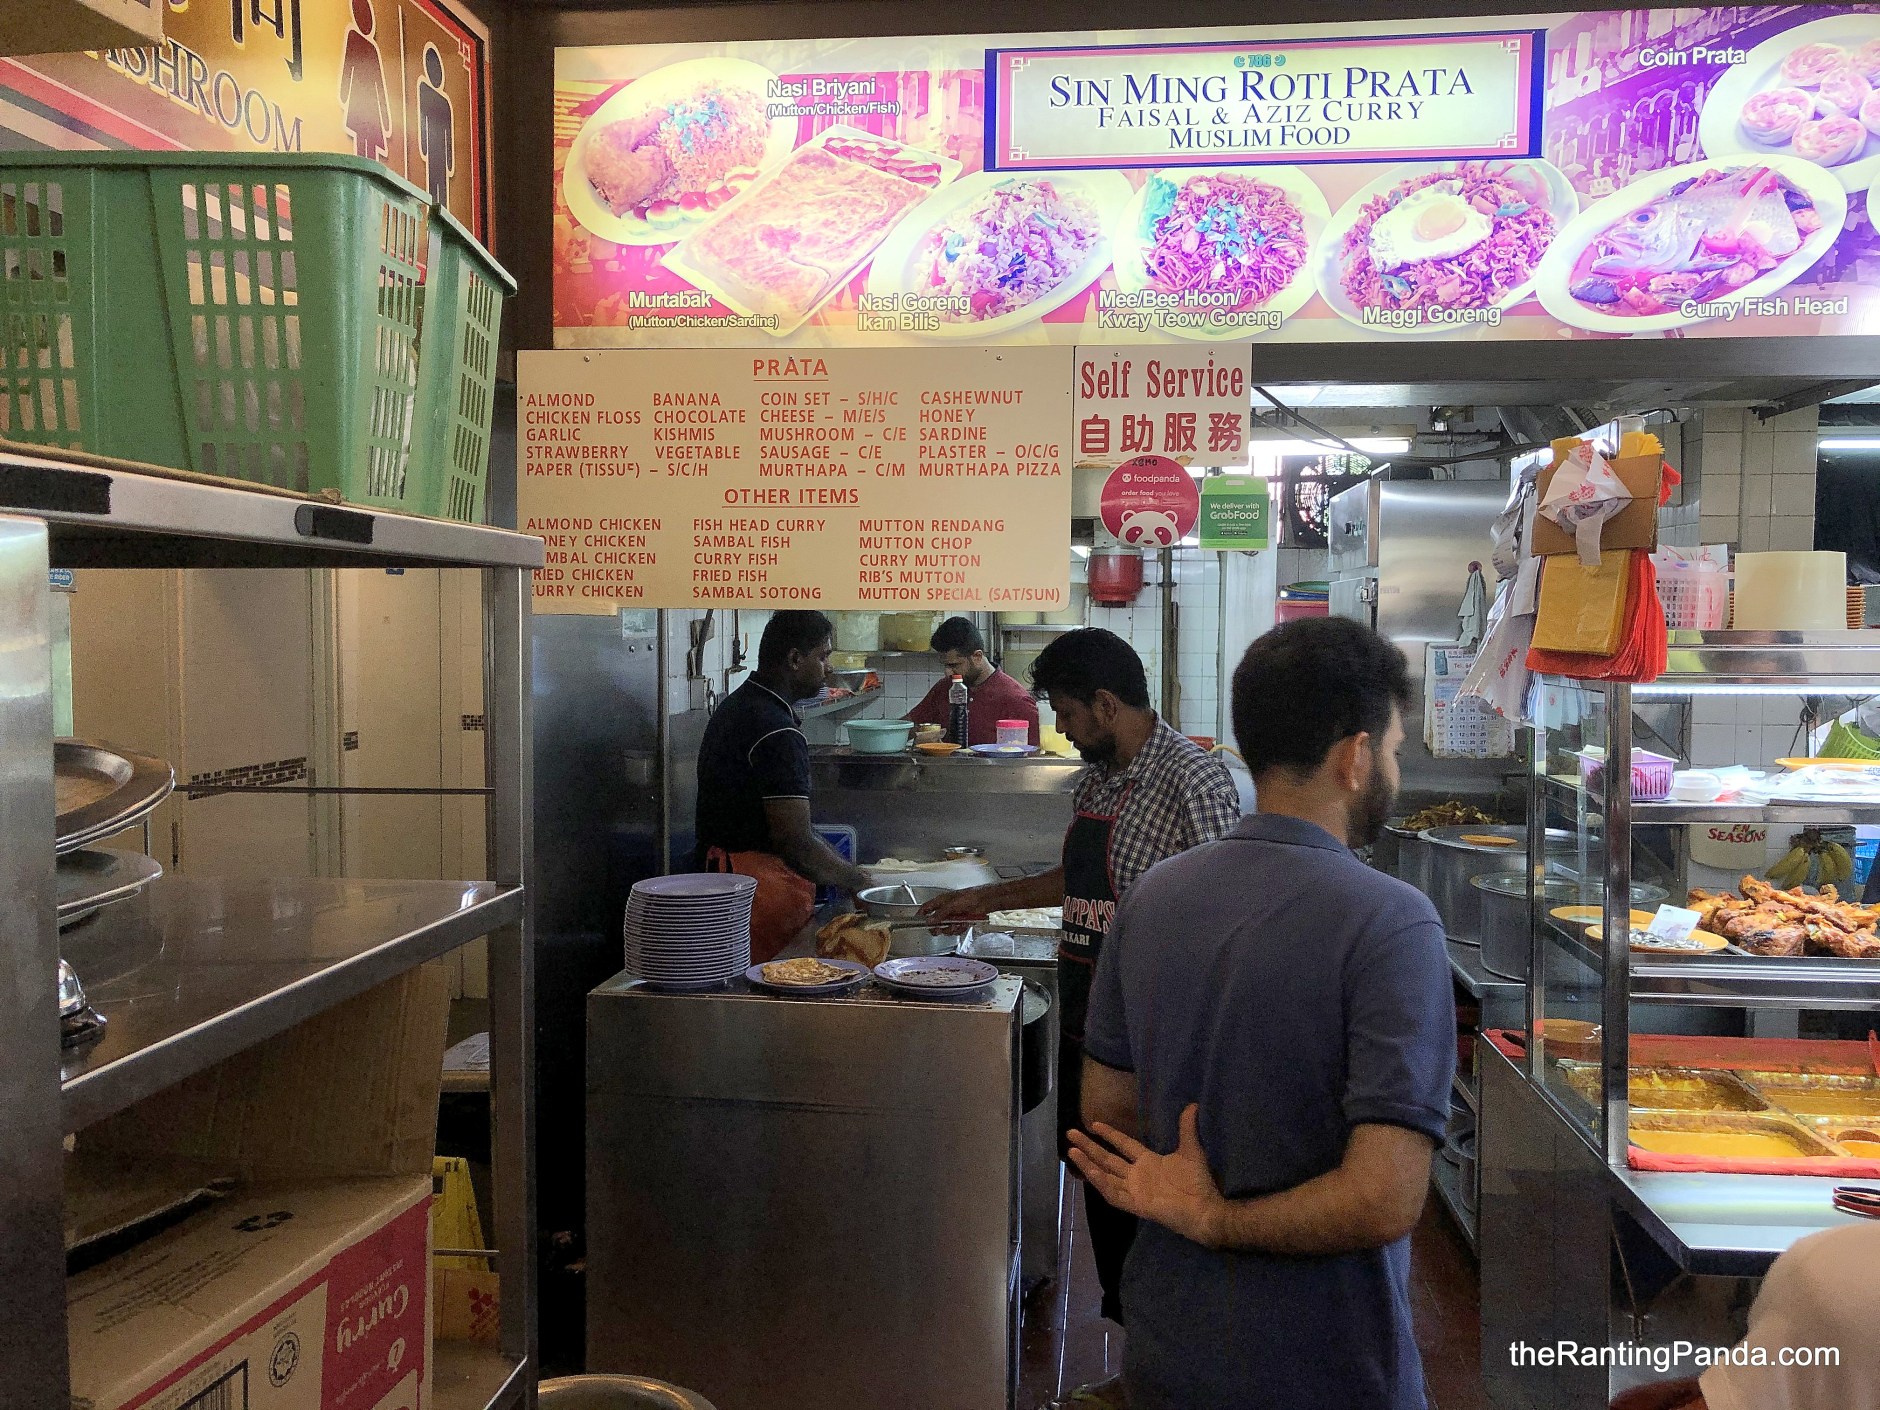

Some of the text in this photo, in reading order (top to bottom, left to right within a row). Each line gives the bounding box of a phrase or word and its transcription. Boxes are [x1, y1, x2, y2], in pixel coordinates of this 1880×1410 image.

[1248, 54, 1271, 67] 786
[1639, 46, 1747, 66] Coin Prata
[767, 78, 876, 100] Nasi Briyani
[1049, 65, 1474, 108] SIN MING ROTI PRATA
[106, 37, 303, 152] SHROOM
[767, 101, 900, 117] (Mutton/Chicken/Fish)
[1097, 99, 1424, 129] FAISAL & AZIZ CURRY
[1168, 125, 1351, 149] MUSLIM FOOD
[629, 291, 712, 309] Murtabak
[858, 293, 971, 316] Nasi Goreng
[1099, 288, 1241, 308] Mee/Bee Hoon/
[1363, 306, 1501, 327] Maggi Goreng
[1680, 297, 1848, 321] Curry Fish Head
[628, 314, 779, 330] (Mutton/Chicken/Sardine)
[858, 313, 940, 331] Ikan Bilis
[1098, 309, 1282, 331] Kway Teow Goreng
[752, 358, 828, 377] PRATA
[1081, 359, 1243, 399] Self Service
[526, 393, 595, 407] ALMOND
[653, 392, 721, 406] BANANA
[760, 392, 798, 406] COIN
[804, 391, 831, 406] SET
[858, 391, 898, 406] S/H/C
[920, 390, 1023, 405] CASHEWNUT
[526, 411, 641, 424] CHICKEN FLOSS
[653, 410, 746, 424] CHOCOLATE
[760, 409, 815, 423] CHEESE
[843, 408, 886, 424] M/E/S
[919, 409, 976, 423] HONEY
[526, 427, 581, 442] GARLIC
[653, 427, 715, 441] KISHMIS
[760, 427, 855, 441] MUSHROOM
[882, 427, 907, 441] C/E
[919, 427, 987, 441] SARDINE
[1080, 411, 1242, 454] 自助服務
[526, 445, 629, 459] STRAWBERRY
[655, 445, 740, 459] VEGETABLE
[760, 445, 830, 459] SAUSAGE
[858, 445, 882, 459] C/E
[919, 445, 987, 459] PLASTER
[1015, 444, 1060, 459] O/C/G
[526, 462, 573, 477] PAPER
[667, 462, 708, 477] S/C/H
[760, 463, 848, 477] MURTHAPA
[875, 463, 905, 477] C/M
[919, 462, 1061, 477] MURTHAPA PIZZA
[1133, 474, 1180, 484] foodpanda
[723, 488, 859, 504] OTHER ITEMS
[1210, 510, 1260, 520] GrabFood
[526, 518, 661, 531] ALMOND CHICKEN
[693, 519, 826, 532] FISH HEAD CURRY
[859, 519, 1005, 533] MUTTON RENDANG
[541, 535, 646, 547] NEY CHICKEN
[693, 536, 791, 548] SAMBAL FISH
[859, 537, 973, 550] MUTTON CHOP
[546, 552, 656, 565] MBAL CHICKEN
[693, 553, 778, 566] CURRY FISH
[859, 554, 981, 567] CURRY MUTTON
[533, 569, 634, 581] RIED CHICKEN
[693, 570, 768, 582] FRIED FISH
[859, 570, 966, 584] RIB'S MUTTON
[532, 584, 643, 598] URRY CHICKEN
[693, 587, 822, 600] SAMBAL SOTONG
[858, 587, 1061, 603] MUTTON SPECIAL (SAT/SUN)
[1708, 828, 1766, 843] SEASONS
[1063, 896, 1116, 934] APPA'S
[336, 1284, 409, 1353] Curry
